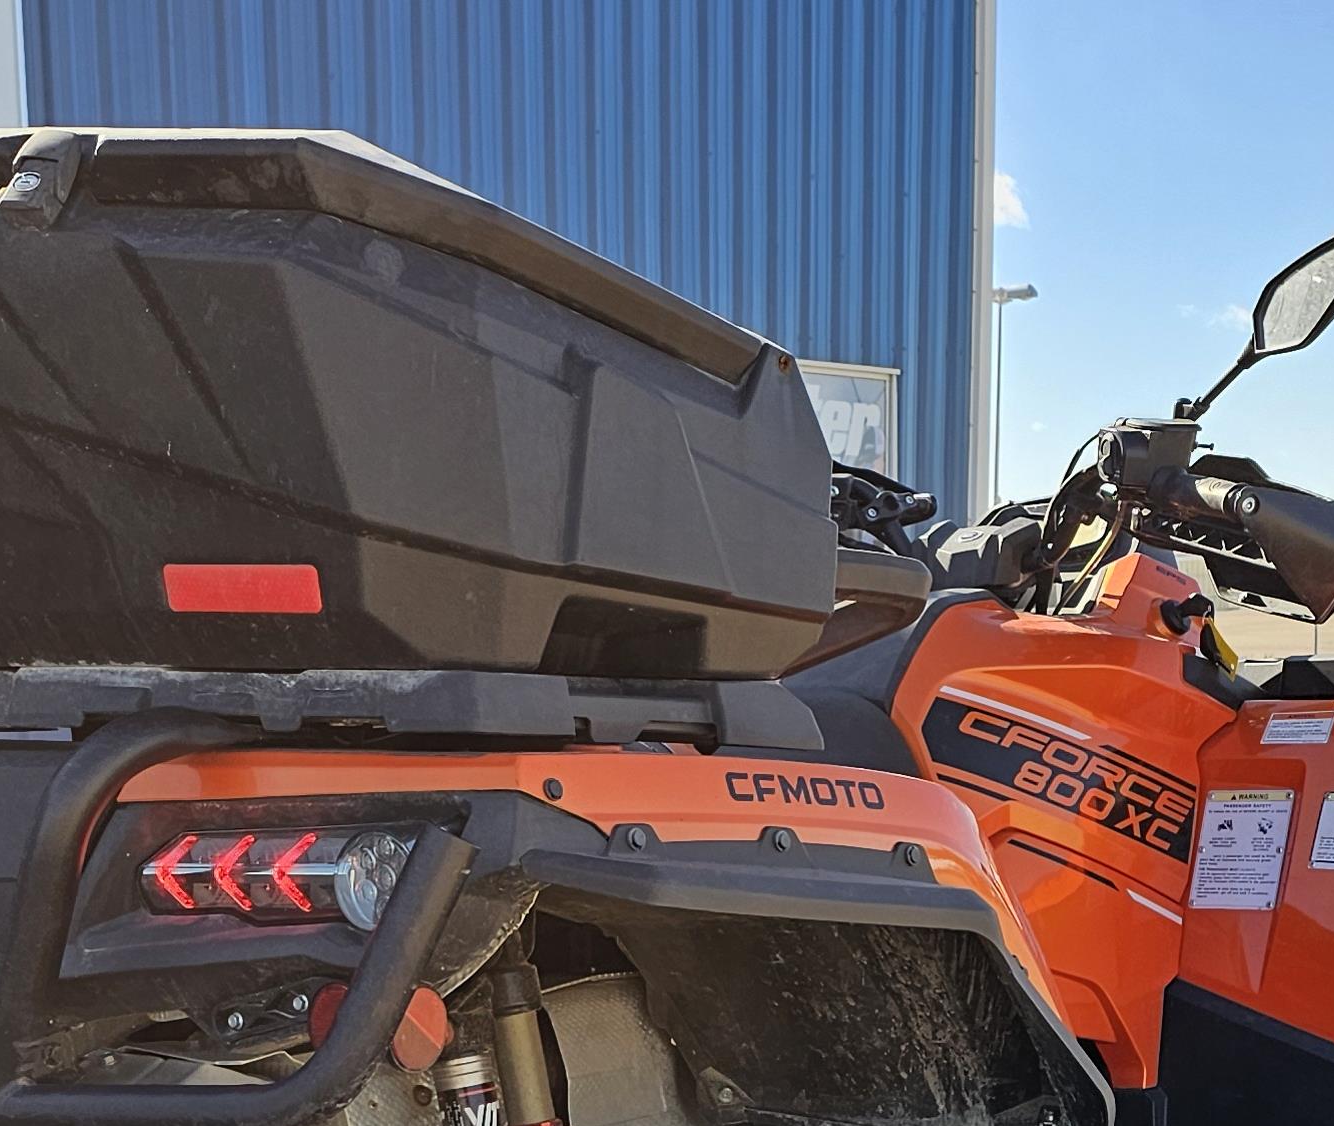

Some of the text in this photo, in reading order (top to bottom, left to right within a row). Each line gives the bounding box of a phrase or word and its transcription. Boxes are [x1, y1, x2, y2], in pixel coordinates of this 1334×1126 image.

[807, 384, 881, 456] er
[725, 772, 885, 810] CFMOTO
[958, 711, 1194, 823] CFORCE
